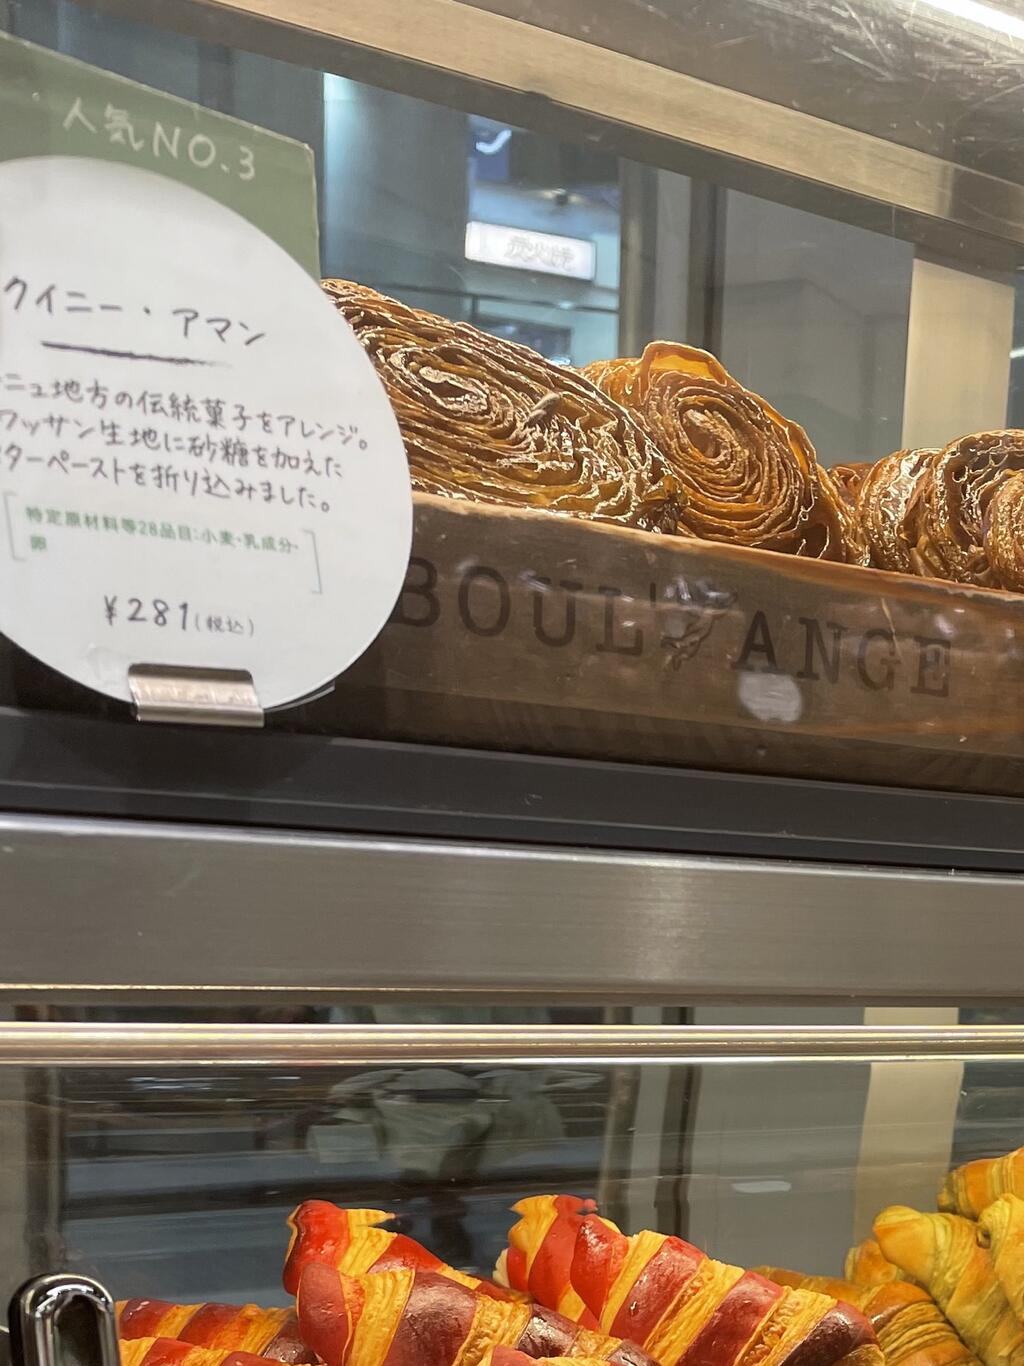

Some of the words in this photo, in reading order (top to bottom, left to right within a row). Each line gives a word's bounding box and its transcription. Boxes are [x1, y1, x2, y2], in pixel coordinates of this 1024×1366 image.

[62, 96, 256, 181] 人気NO.3
[4, 275, 266, 346] クイニー・アマン
[0, 372, 369, 451] ニュ地方の伝統菓子をアレンジ。
[0, 442, 331, 514] ターペーストを折り込みました。
